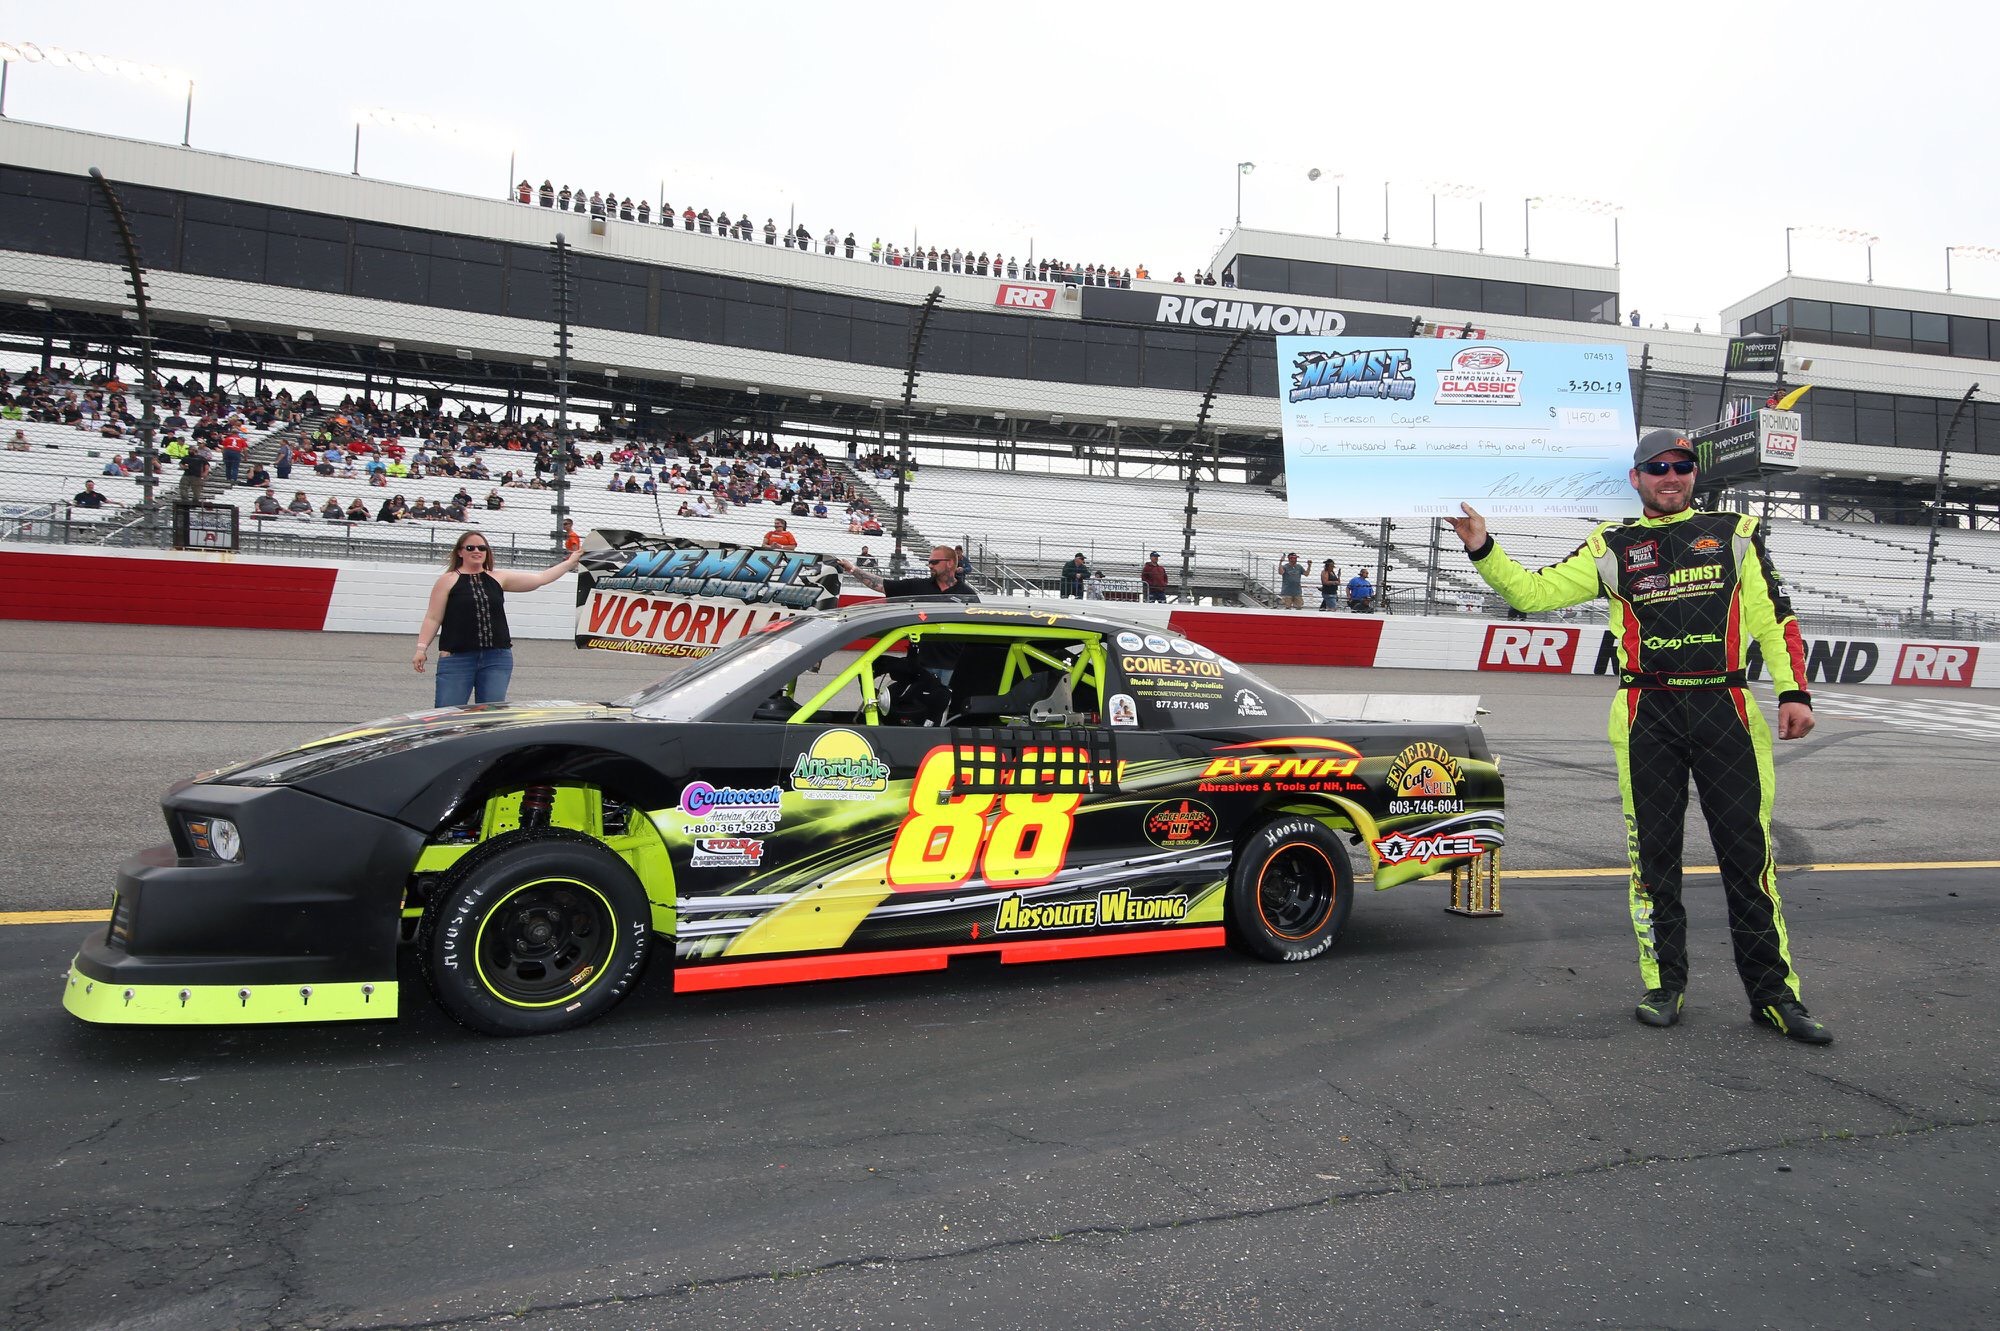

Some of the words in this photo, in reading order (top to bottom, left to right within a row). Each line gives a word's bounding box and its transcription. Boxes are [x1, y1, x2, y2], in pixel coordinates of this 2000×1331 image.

[1004, 287, 1048, 307] RR
[1155, 296, 1346, 337] RICHMOND
[1584, 352, 1613, 361] 074513
[1745, 343, 1777, 351] MONSTER
[1300, 348, 1408, 389] NEMST
[1442, 381, 1516, 393] CLASSIC
[1323, 412, 1376, 424] Emerson
[1549, 406, 1556, 418] $
[1762, 413, 1799, 431] RICHMOND
[1299, 437, 1329, 455] One
[1336, 439, 1387, 452] thousand
[1426, 440, 1468, 451] hundred
[1505, 442, 1525, 450] and
[1768, 434, 1795, 450] RR
[619, 550, 820, 584] NEMST
[1669, 565, 1723, 587] NEMST
[1651, 590, 1668, 598] EAST
[1687, 583, 1710, 592] STOCK
[588, 593, 739, 645] VICTORY
[1486, 628, 1563, 667] RR
[1122, 657, 1222, 677] COME-2-YOU
[1899, 647, 1966, 682] RR
[1130, 677, 1154, 686] Mobile
[1156, 678, 1189, 690] Detailing
[1191, 680, 1224, 690] Specialists
[1667, 678, 1704, 686] EMERSON
[1704, 676, 1727, 685] CAYER
[1155, 700, 1210, 710] 877.917.1405
[793, 754, 888, 780] Affordable
[1200, 757, 1362, 778] ATNH
[1388, 741, 1466, 785] EVERYDAY
[806, 775, 848, 790] Mowing
[851, 776, 875, 789] Plus
[1199, 783, 1259, 792] Abrasives
[1262, 782, 1272, 791] &
[1275, 782, 1306, 791] Tools
[1309, 781, 1321, 791] of
[1324, 782, 1343, 792] NH,
[1346, 781, 1366, 791] Inc.
[1403, 766, 1433, 790] Cafe
[1424, 782, 1431, 794] &
[1433, 782, 1452, 794] PUB
[689, 787, 782, 811] Contoocook
[1389, 799, 1465, 814] 603-746-6041
[886, 744, 1092, 893] 88
[1157, 812, 1179, 822] RACE
[1179, 811, 1205, 821] PARTS
[683, 823, 775, 834] 1-800-367-9283
[1170, 823, 1189, 834] NH
[1264, 819, 1316, 848] Hoosier
[708, 839, 751, 849] TURN
[743, 841, 763, 859] 4
[1410, 836, 1483, 861] AXCEL
[998, 897, 1096, 930] ABSOLUTE
[1101, 891, 1185, 922] WELDING
